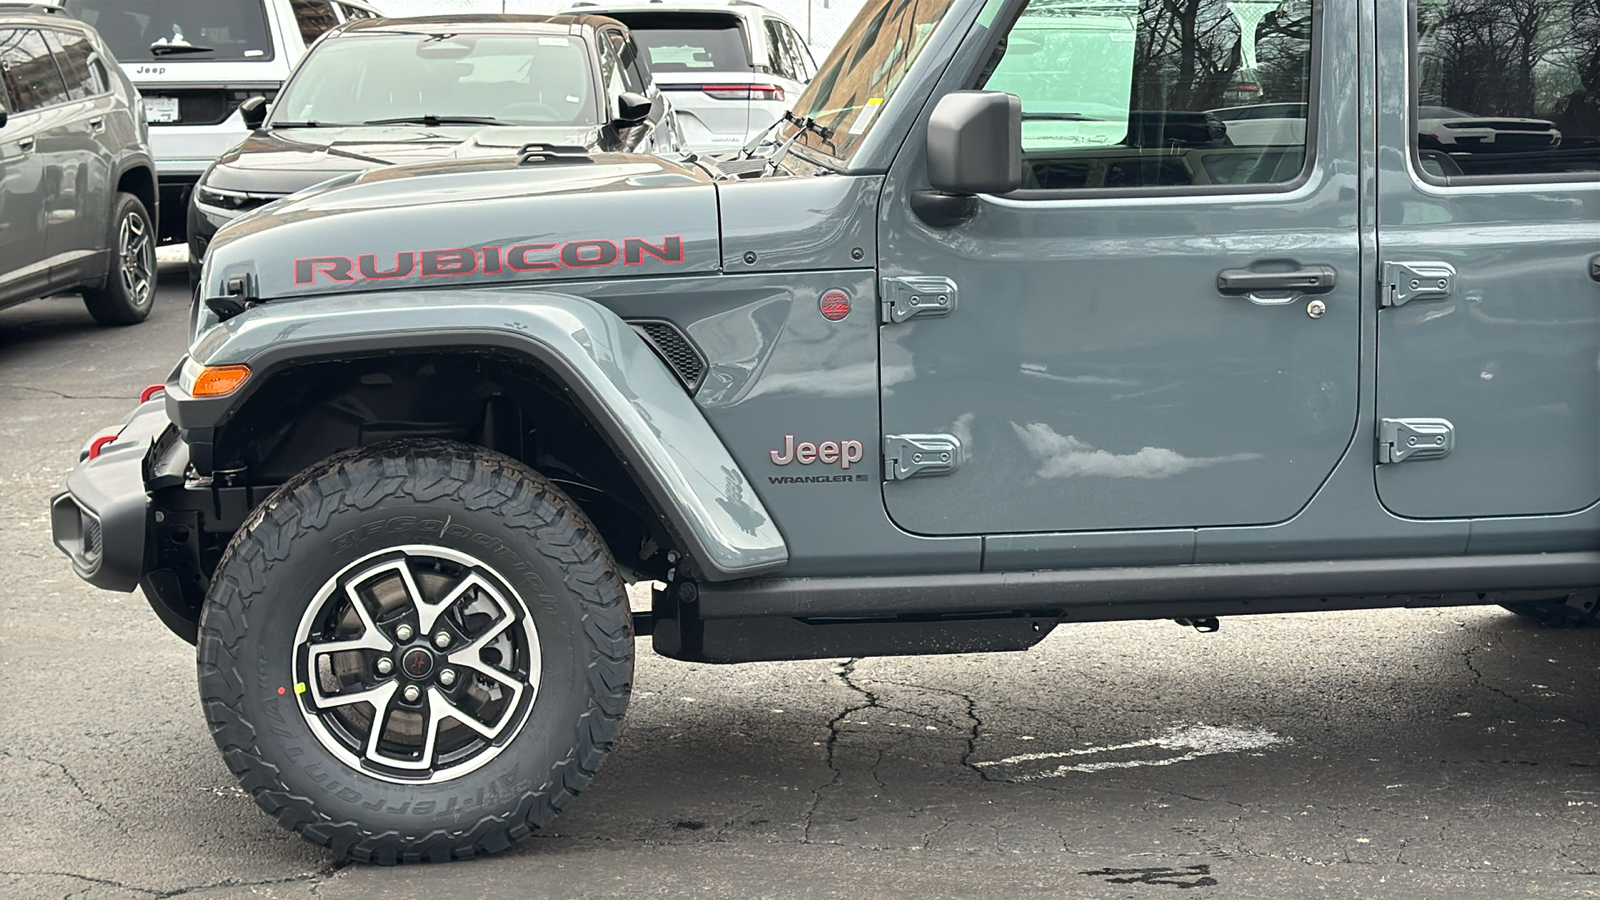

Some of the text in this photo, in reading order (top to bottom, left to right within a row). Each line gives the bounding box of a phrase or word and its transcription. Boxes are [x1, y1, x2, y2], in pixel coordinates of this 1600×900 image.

[136, 66, 166, 75] Jeep
[293, 235, 684, 286] RUBICON
[769, 435, 864, 469] Jeep
[768, 474, 853, 485] WRANGLER
[330, 515, 558, 616] BFGoodrich
